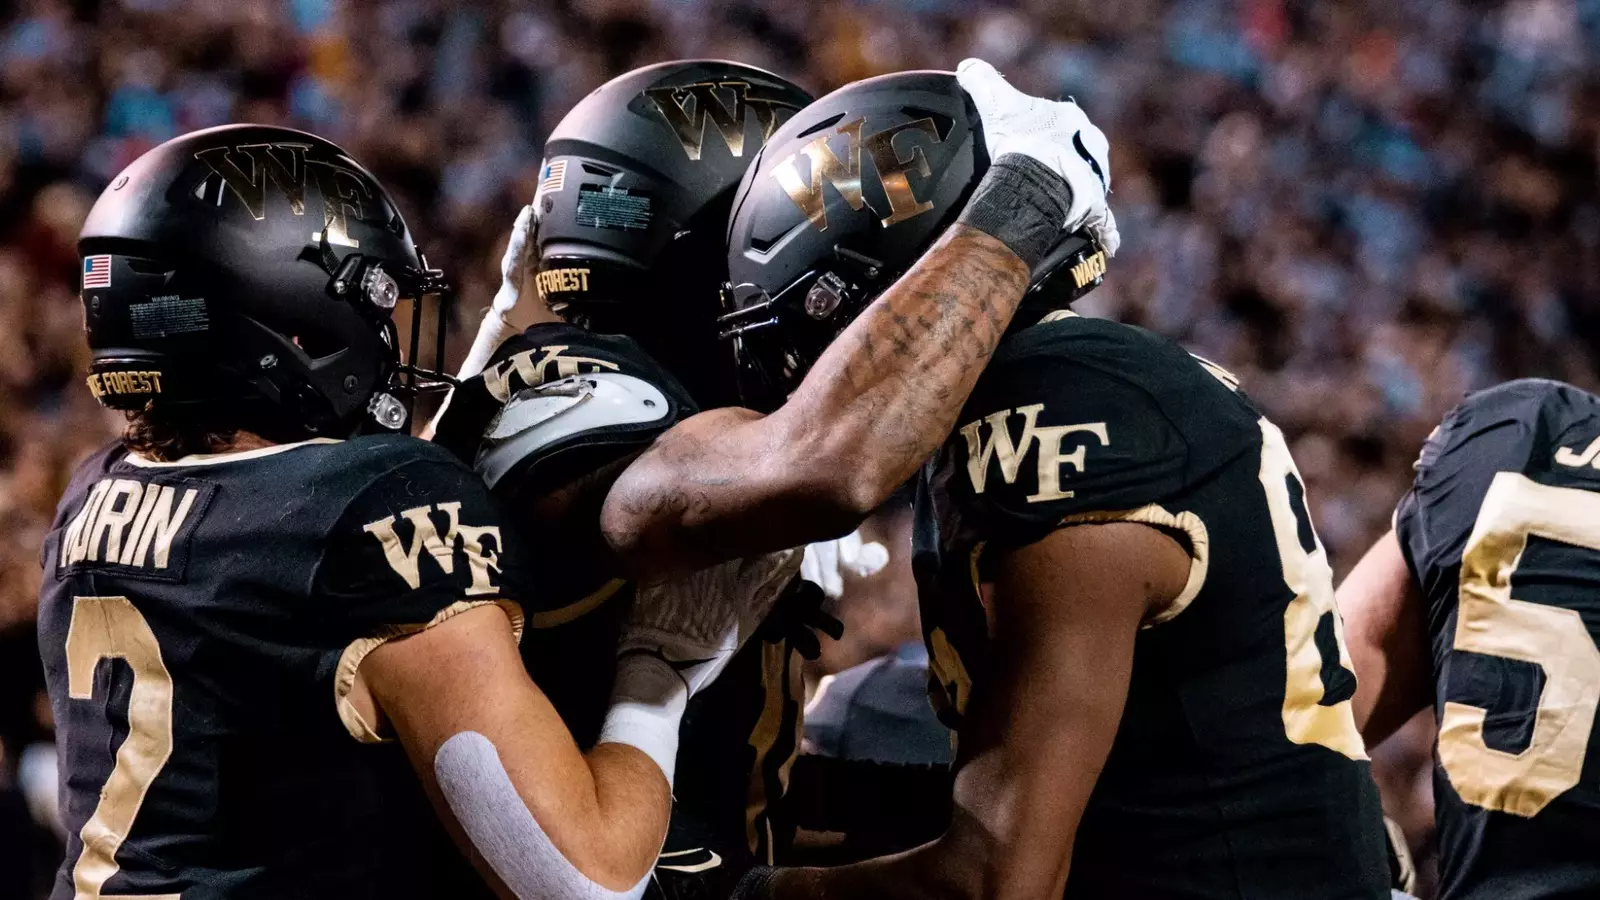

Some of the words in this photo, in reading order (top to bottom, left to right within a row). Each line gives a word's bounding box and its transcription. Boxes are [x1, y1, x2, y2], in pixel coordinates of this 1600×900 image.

[194, 142, 373, 249] WF
[770, 115, 949, 232] WF
[544, 268, 590, 293] FOREST
[102, 371, 162, 394] FOREST
[960, 403, 1109, 503] WF
[363, 501, 503, 595] WF
[1437, 471, 1600, 818] 5
[66, 595, 181, 900] 2
